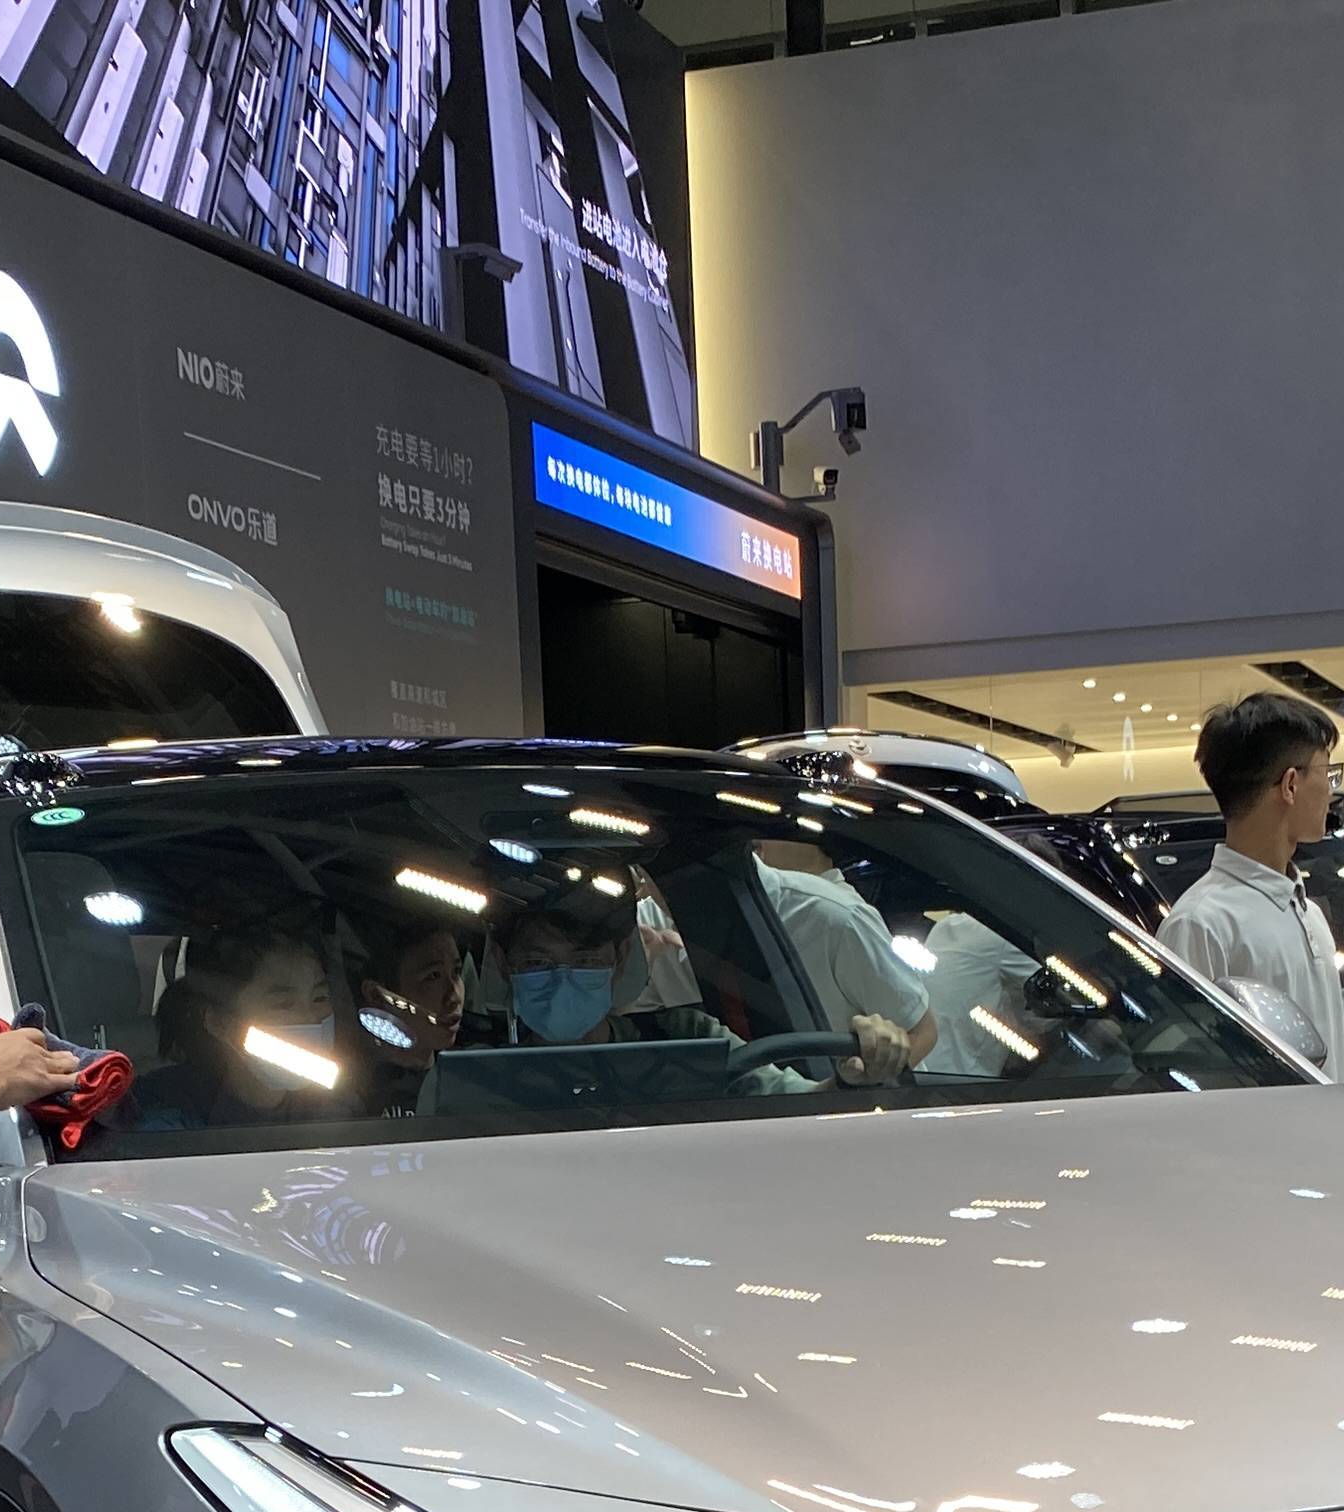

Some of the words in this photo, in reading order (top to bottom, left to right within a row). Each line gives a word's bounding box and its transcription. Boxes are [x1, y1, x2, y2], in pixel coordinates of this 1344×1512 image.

[176, 347, 246, 400] NIO蔚来
[188, 493, 278, 546] ONVO乐道
[378, 472, 471, 534] 换电只要3分钟
[741, 530, 793, 580] 蔚来换电站
